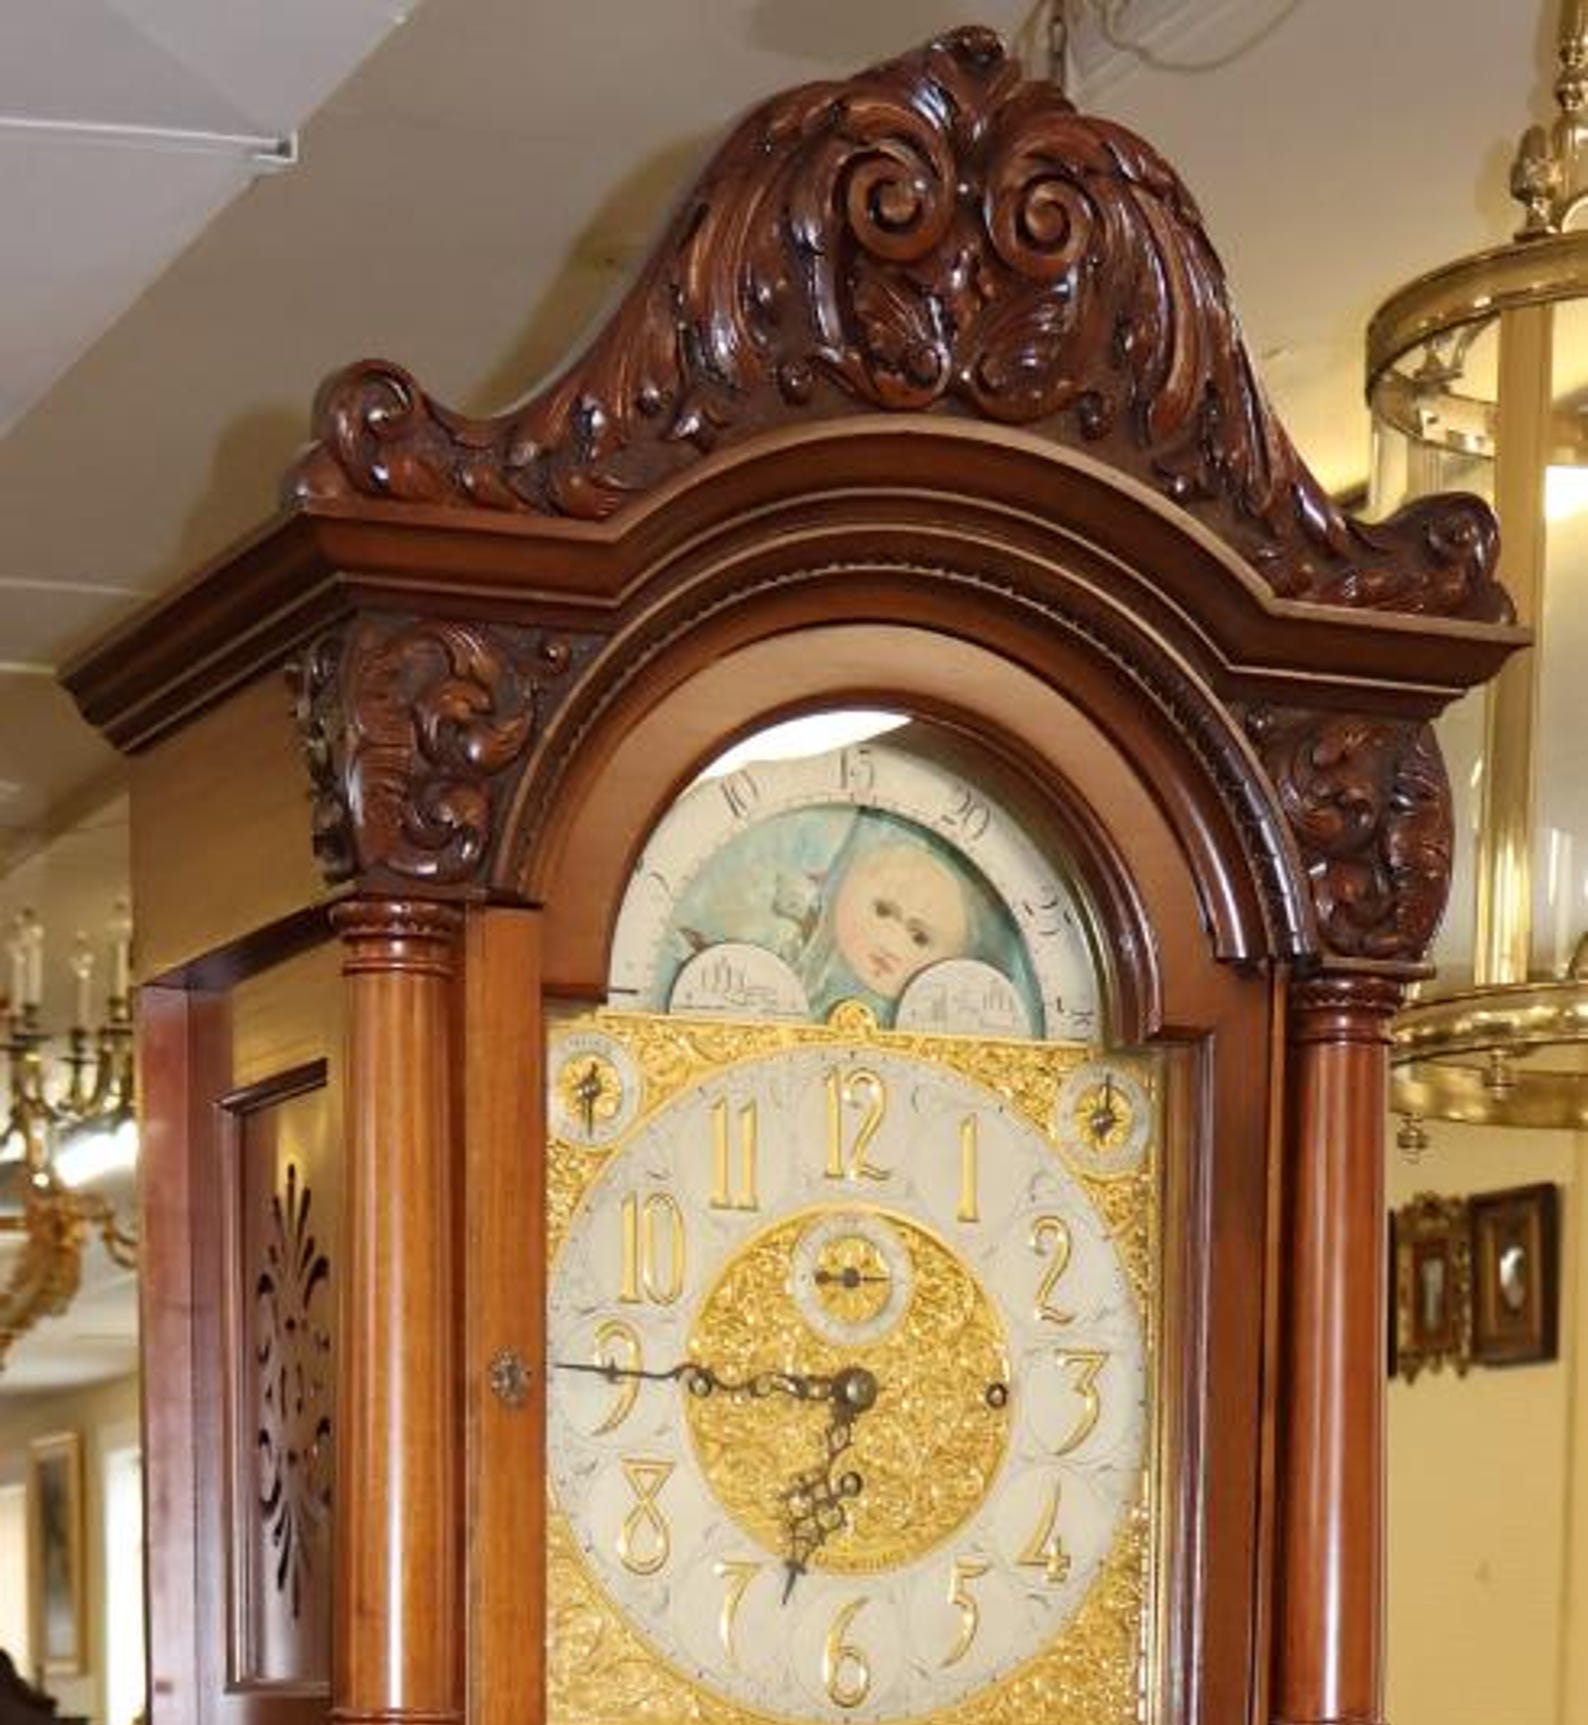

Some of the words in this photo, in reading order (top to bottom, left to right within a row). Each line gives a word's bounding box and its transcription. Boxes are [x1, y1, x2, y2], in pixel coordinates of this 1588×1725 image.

[710, 1100, 759, 1211] 11
[823, 1066, 891, 1182] 12
[957, 1113, 980, 1223] 1
[619, 1192, 685, 1307] 10
[1031, 1215, 1073, 1325] 2
[592, 1320, 642, 1437] 9
[1055, 1348, 1110, 1457] 3
[617, 1458, 673, 1576] 8
[1016, 1479, 1072, 1583] 4
[715, 1561, 760, 1662] 7
[824, 1598, 871, 1709] 6
[942, 1556, 990, 1668] 5
